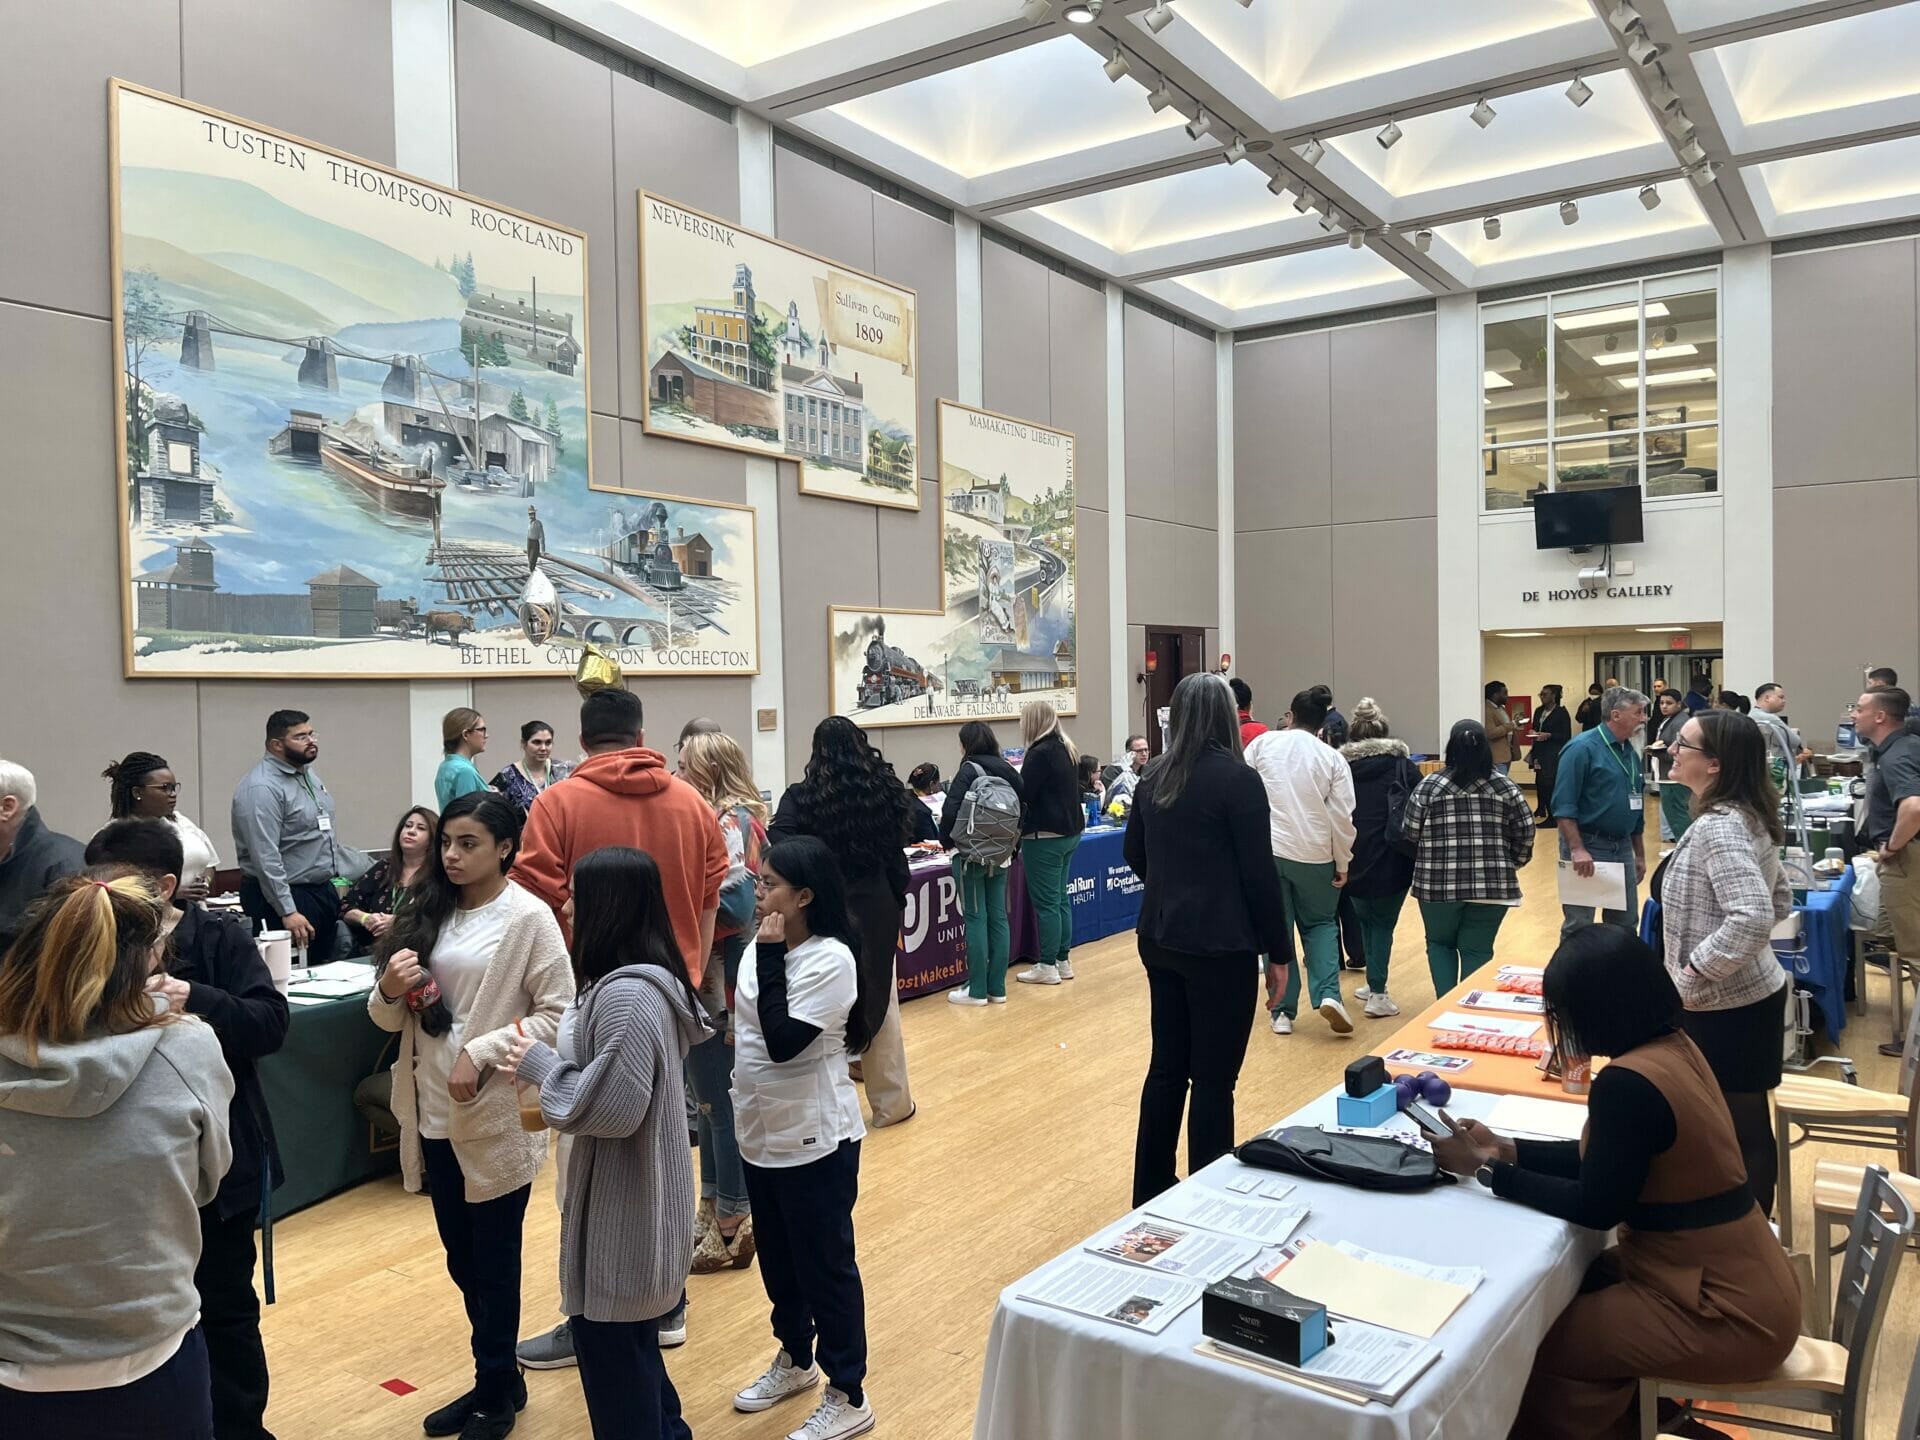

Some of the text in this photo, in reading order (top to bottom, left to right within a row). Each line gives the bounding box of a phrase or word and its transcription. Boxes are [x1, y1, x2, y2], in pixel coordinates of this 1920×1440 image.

[202, 120, 573, 256] TUSTEN THOMPSON ROCKLAND
[652, 203, 735, 248] NEVERSINK
[835, 291, 902, 327] Sullivan County
[855, 322, 883, 344] 1809
[969, 414, 1061, 447] MAMAKATING LIBERTY
[1522, 584, 1673, 602] DE HOYOS GALLERY
[461, 647, 749, 666] BETHEL CALOON COCHECTON
[914, 705, 960, 719] DELAWARE
[967, 702, 1013, 716] FALLSBURG
[1113, 874, 1134, 888] Crystal
[1073, 890, 1095, 906] HEALTH
